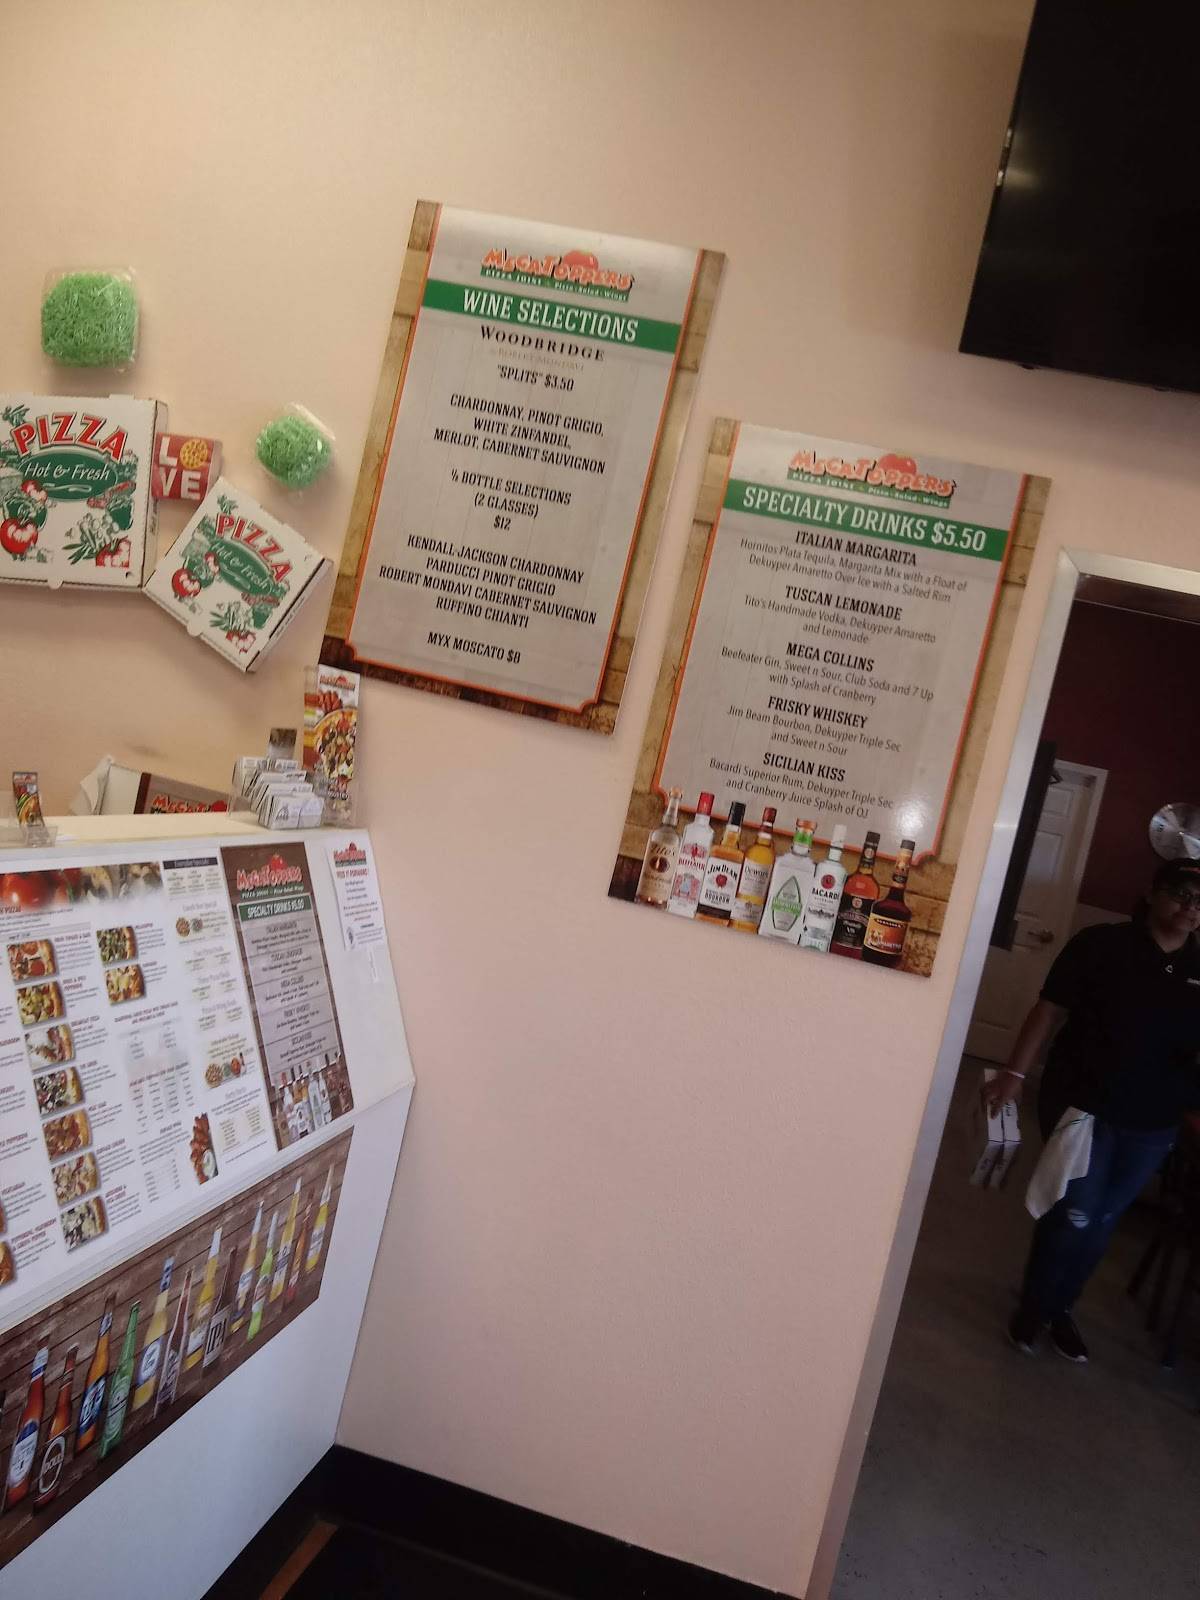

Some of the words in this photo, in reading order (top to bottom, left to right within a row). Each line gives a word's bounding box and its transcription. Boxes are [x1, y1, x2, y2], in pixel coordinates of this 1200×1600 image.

[464, 289, 513, 318] WINE
[517, 300, 638, 341] SELECTIONS
[544, 373, 574, 391] $3.50
[474, 417, 508, 435] WHITE
[527, 409, 562, 427] PINOT
[10, 411, 129, 463] PIZZA
[24, 461, 51, 479] Hot
[71, 463, 111, 481] Fresh
[482, 437, 540, 460] CABERNET
[540, 450, 605, 474] SAUVIGNON
[461, 471, 503, 490] BOTTLE
[504, 480, 571, 505] SELECTIONS
[791, 472, 823, 485] PIZZA
[474, 491, 485, 507] (2
[487, 495, 539, 519] GLASSES)
[743, 486, 848, 525] SPECIALTY
[850, 506, 927, 539] DRINKS
[931, 521, 986, 551] $5.50
[493, 514, 511, 531] $12
[215, 512, 293, 584] PIZZA
[795, 530, 843, 551] ITALIAN
[845, 540, 916, 567] MARGARITA
[426, 556, 480, 580] PARDUCCI
[482, 569, 516, 587] PINOT
[517, 577, 556, 596] GRIGIO
[509, 556, 584, 584] CHARDONNAY
[749, 553, 791, 572] Dekuyper
[792, 562, 833, 579] Amaretto
[834, 570, 855, 583] Over
[857, 574, 871, 586] Ice
[872, 580, 892, 591] with
[893, 585, 899, 593] a
[901, 583, 931, 599] Salted
[779, 545, 801, 559] Plata
[838, 556, 882, 575] Margarita
[903, 571, 923, 583] with
[925, 576, 931, 585] a
[956, 581, 967, 591] of
[379, 565, 422, 585] ROBERT
[422, 575, 472, 597] MONDAVI
[474, 586, 532, 610] CABERNET
[532, 599, 597, 624] SAUVIGNON
[785, 585, 833, 606] TUSCAN
[835, 595, 903, 620] LEMONADE
[435, 596, 482, 617] RUFFINO
[484, 607, 529, 628] CHIANTI
[767, 599, 817, 619] Handmade
[849, 616, 893, 635] Dekuyper
[893, 625, 936, 643] Amaretto
[427, 631, 451, 648] MYX
[452, 637, 505, 660] MOSCATO
[802, 623, 820, 633] and
[821, 624, 869, 644] Lemonade
[786, 642, 820, 661] MEGA
[823, 650, 874, 672] COLLINS
[769, 673, 788, 685] with
[790, 676, 820, 691] Splash
[821, 683, 831, 694] of
[832, 686, 876, 706] Cranberry
[784, 660, 811, 675] Sweet
[845, 672, 866, 686] Club
[868, 677, 890, 691] Soda
[891, 684, 911, 696] and
[920, 688, 934, 703] Up
[728, 704, 744, 717] Jim
[745, 708, 771, 723] Beam
[772, 714, 812, 734] Bourbon,
[814, 723, 857, 742] Dekuyper
[884, 738, 901, 753] Sec
[767, 695, 811, 716] FRISKY
[813, 705, 868, 728] WHISKEY
[771, 732, 789, 742] and
[790, 734, 817, 749] Sweet
[826, 742, 847, 755] Sour
[709, 758, 741, 774] Bacardi
[743, 765, 780, 783] Superior
[781, 774, 804, 790] Rum,
[806, 779, 849, 799] Dekuyper
[877, 795, 893, 809] Sec
[763, 751, 815, 775] SICILIAN
[817, 764, 846, 782] KISS
[726, 779, 744, 789] and
[744, 781, 787, 801] Cranberry
[788, 791, 812, 806] Juice
[813, 796, 843, 813] Splash
[844, 805, 855, 815] of
